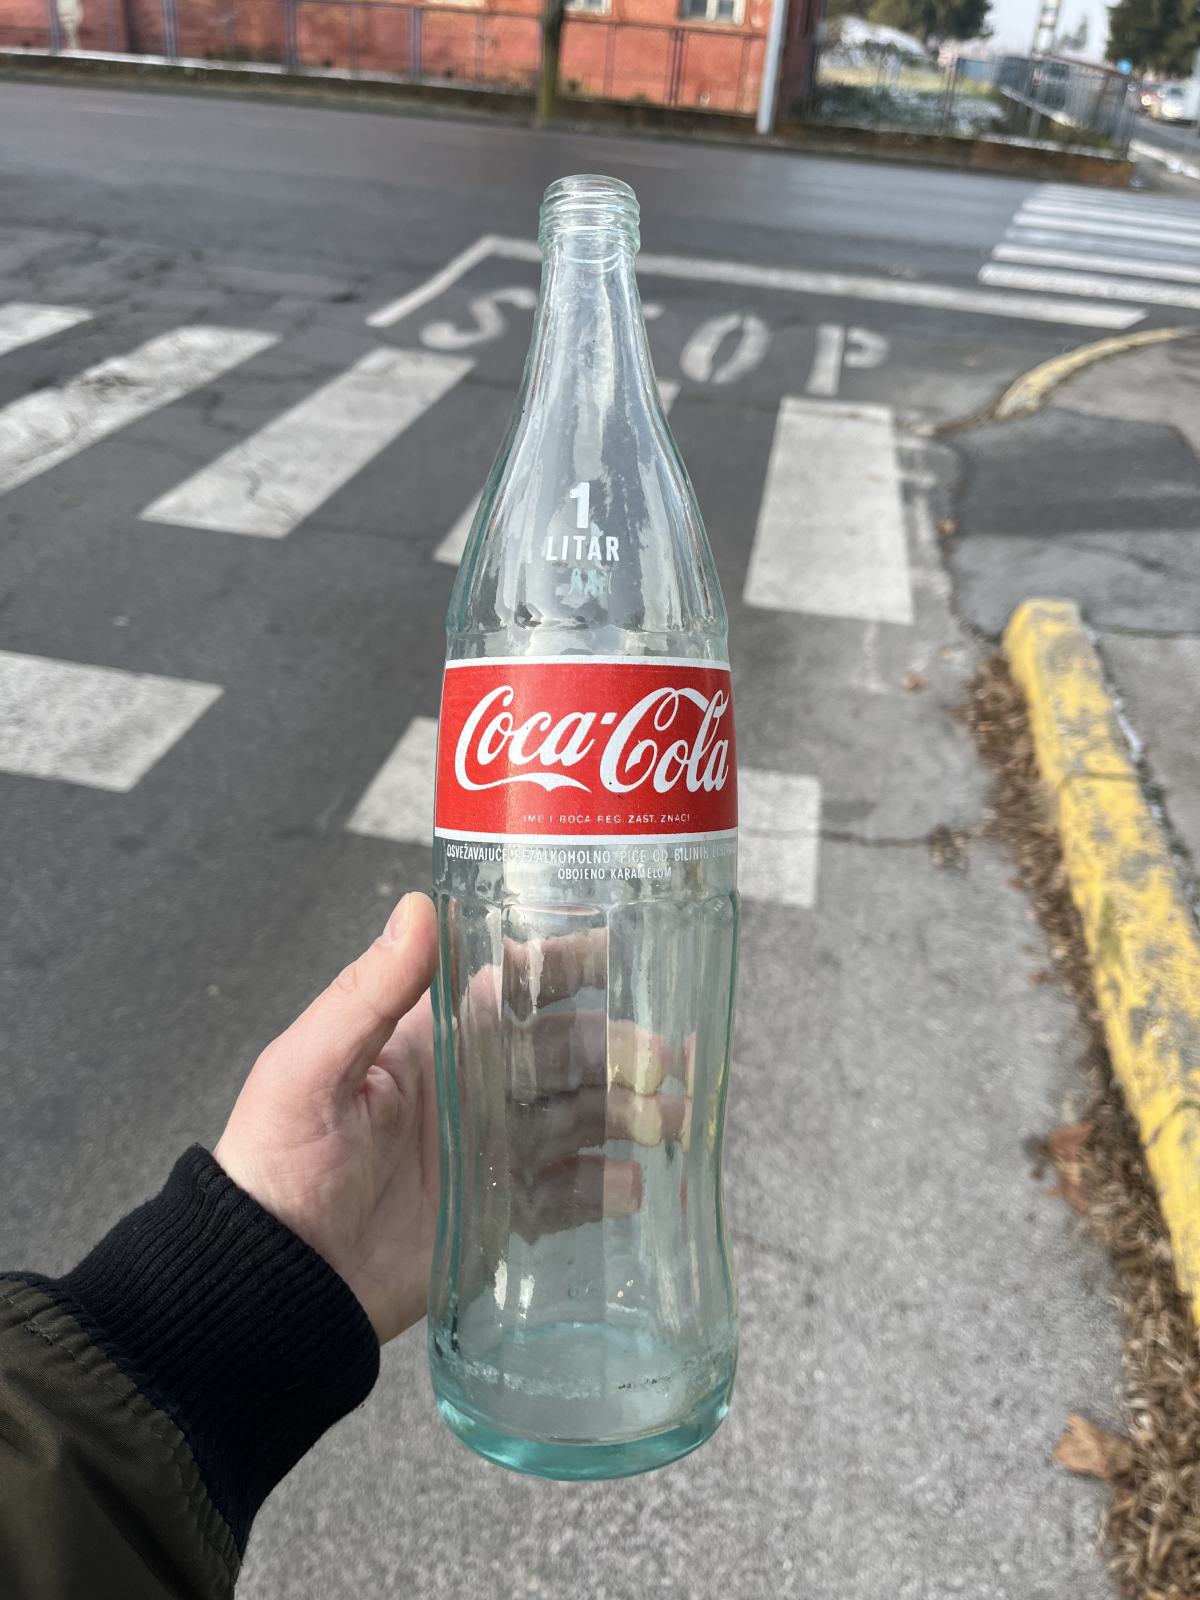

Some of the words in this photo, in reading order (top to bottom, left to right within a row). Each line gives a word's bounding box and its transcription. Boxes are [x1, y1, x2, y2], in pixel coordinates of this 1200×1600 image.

[419, 287, 891, 396] SOP
[569, 481, 590, 529] 1
[545, 535, 620, 562] LITAR
[454, 685, 729, 793] Coca-Cola
[523, 815, 543, 823] IME
[559, 815, 590, 824] BOCA
[652, 847, 668, 861] OD
[557, 868, 605, 880] OBOJENO
[610, 866, 673, 881] KARAMELOM
